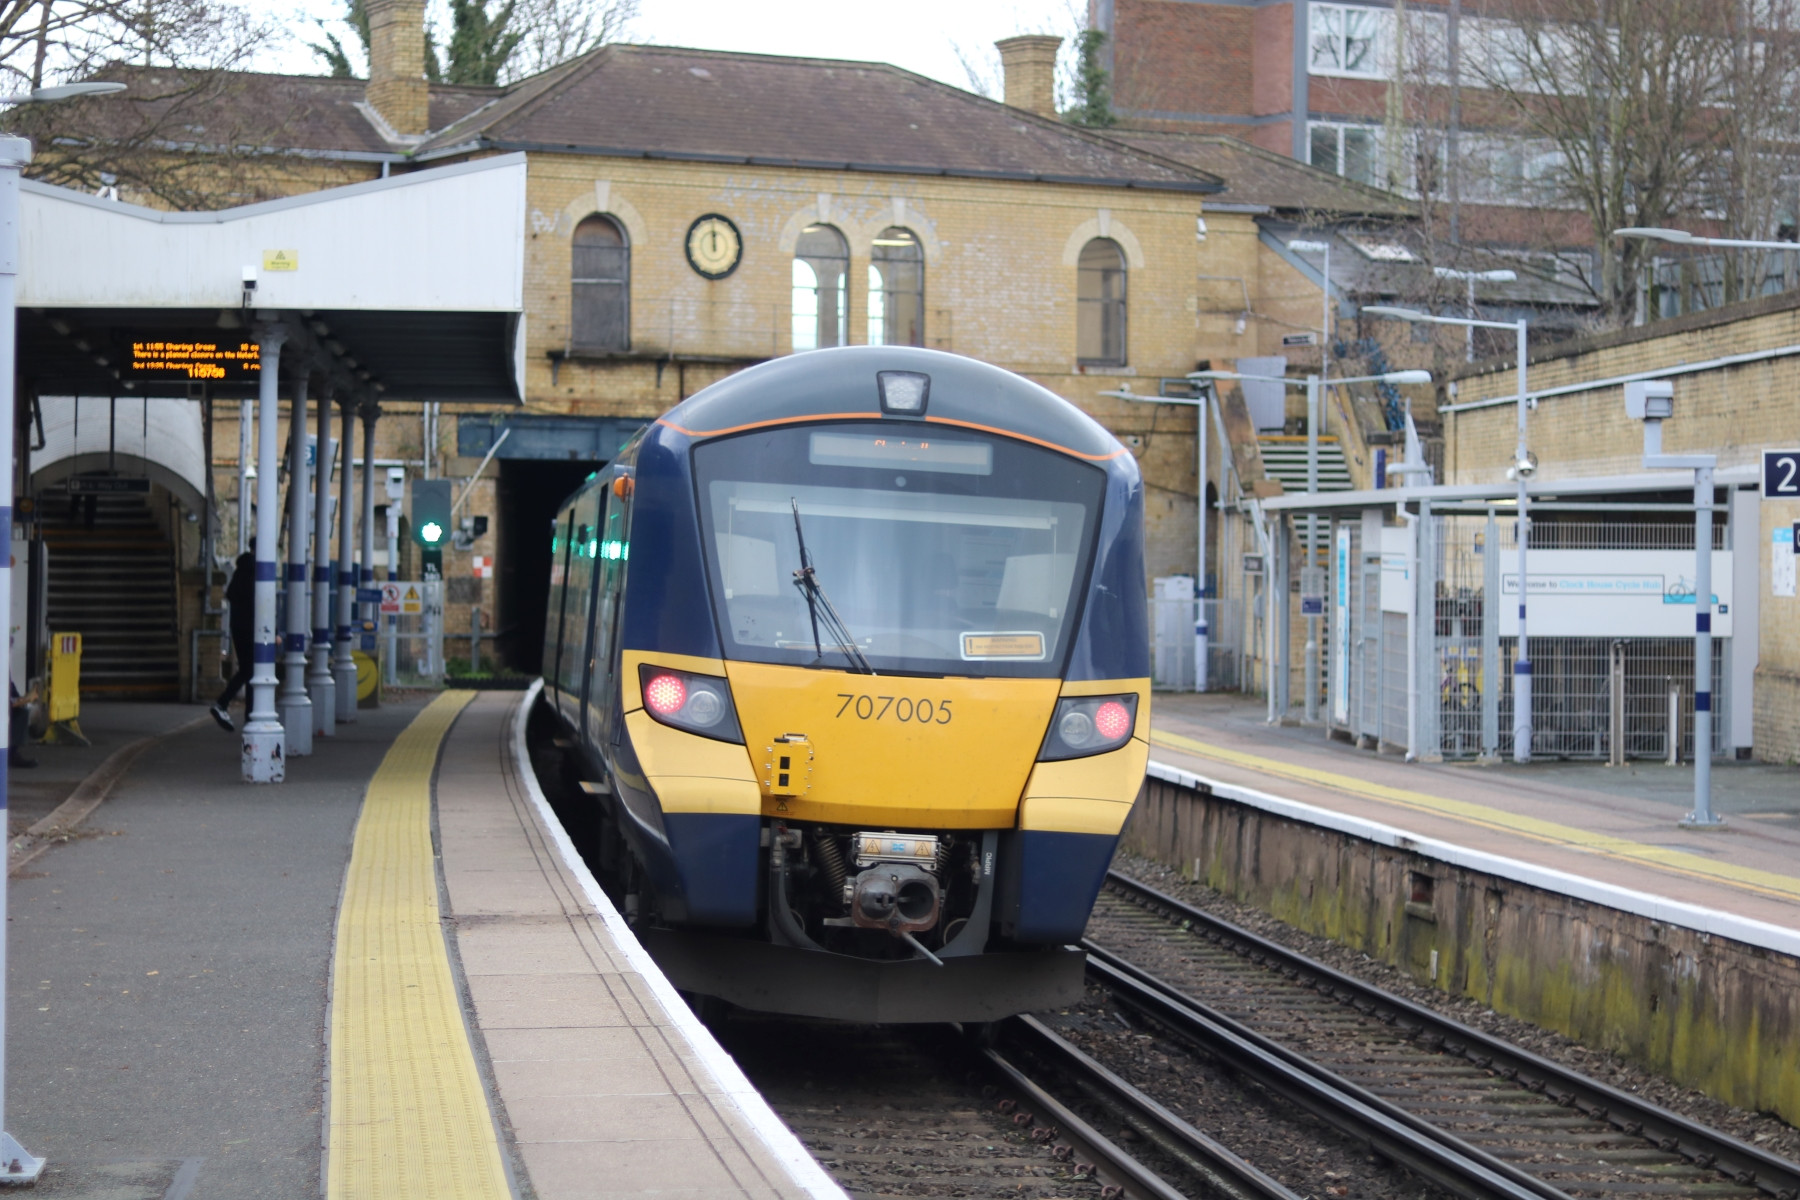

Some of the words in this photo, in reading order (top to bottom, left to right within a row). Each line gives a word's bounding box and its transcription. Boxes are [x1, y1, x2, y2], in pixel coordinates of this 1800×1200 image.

[1776, 457, 1798, 492] 2
[1507, 580, 1546, 588] Weome
[1549, 580, 1558, 588] to
[1559, 580, 1585, 589] Clock
[1587, 580, 1613, 589] House
[835, 693, 952, 725] 707005
